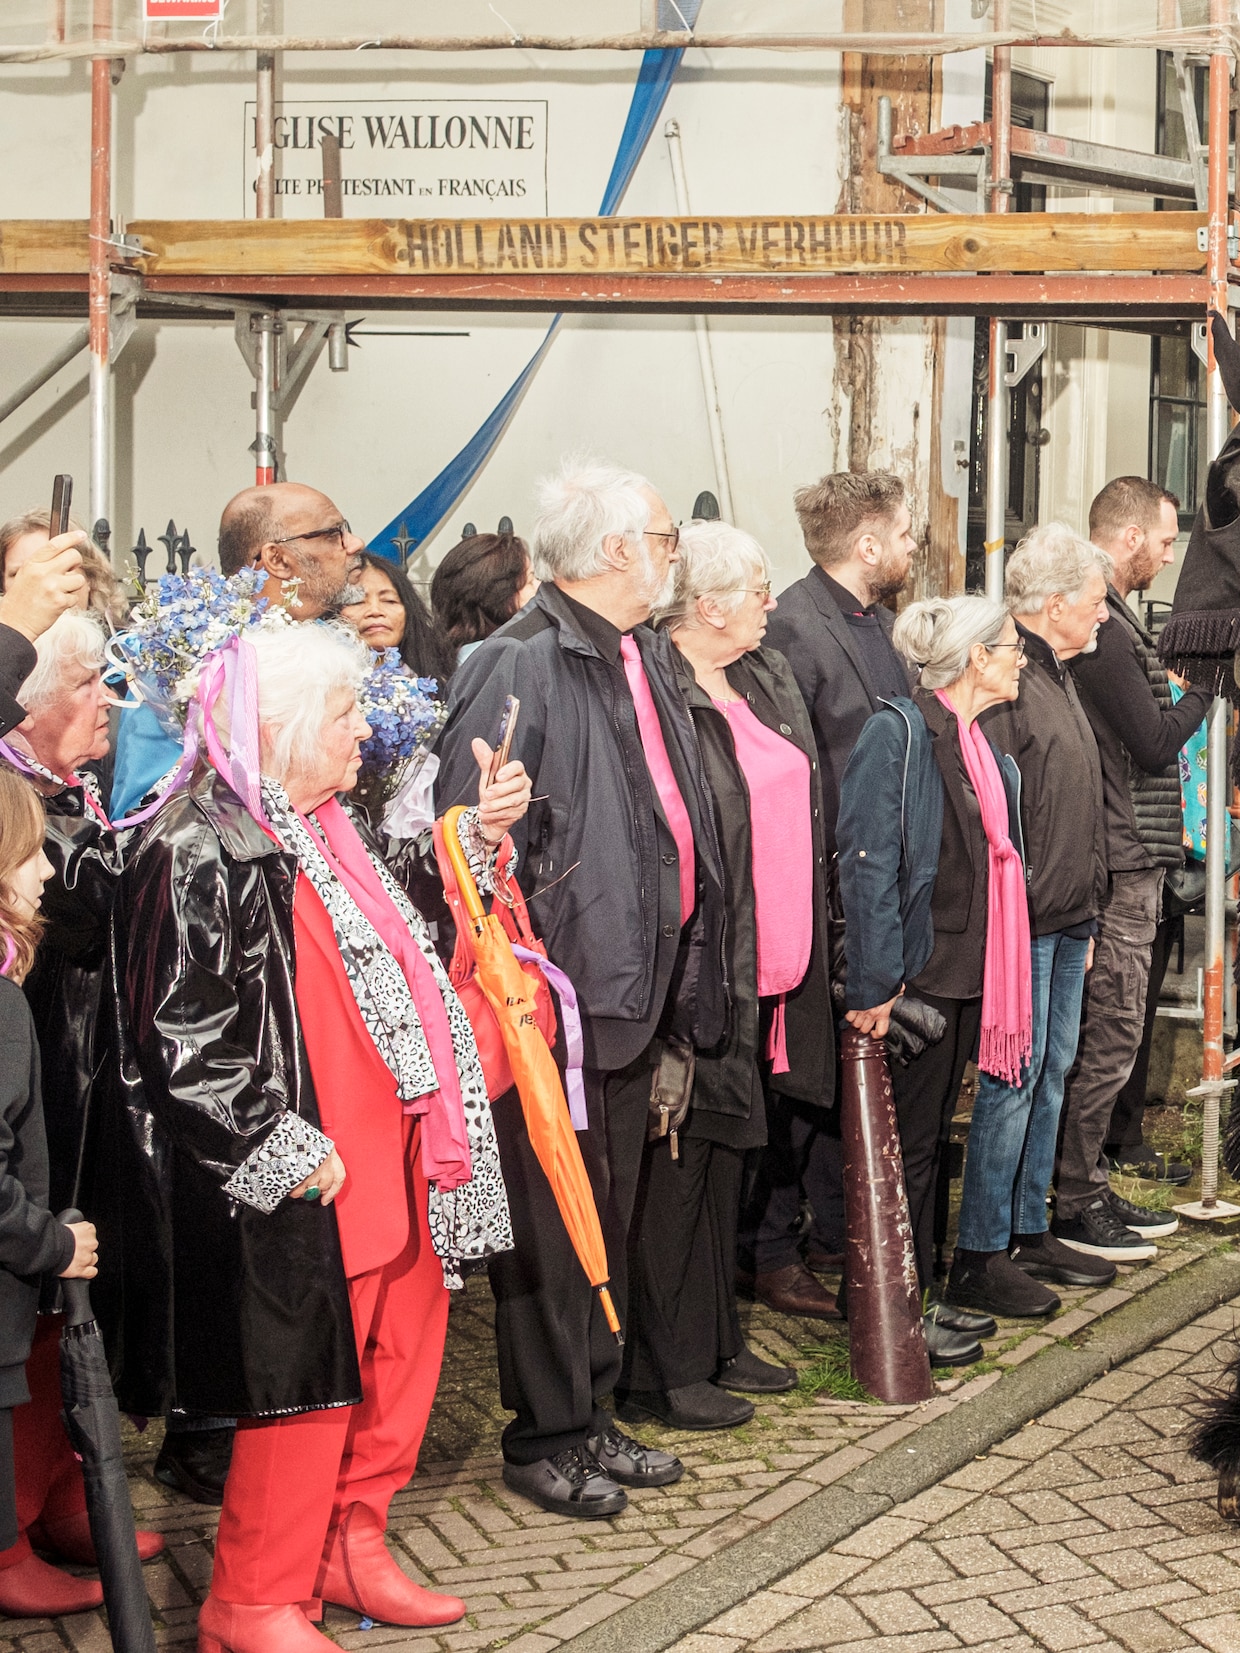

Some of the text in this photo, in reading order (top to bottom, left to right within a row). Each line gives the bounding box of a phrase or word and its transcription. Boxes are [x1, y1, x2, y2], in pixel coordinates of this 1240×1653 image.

[252, 115, 535, 149] GLISE WALLONNE
[253, 178, 527, 203] LTE PRTESTANT EN FRANÇAIS
[405, 220, 907, 269] HOLLAND STEIGER VERHUUR
